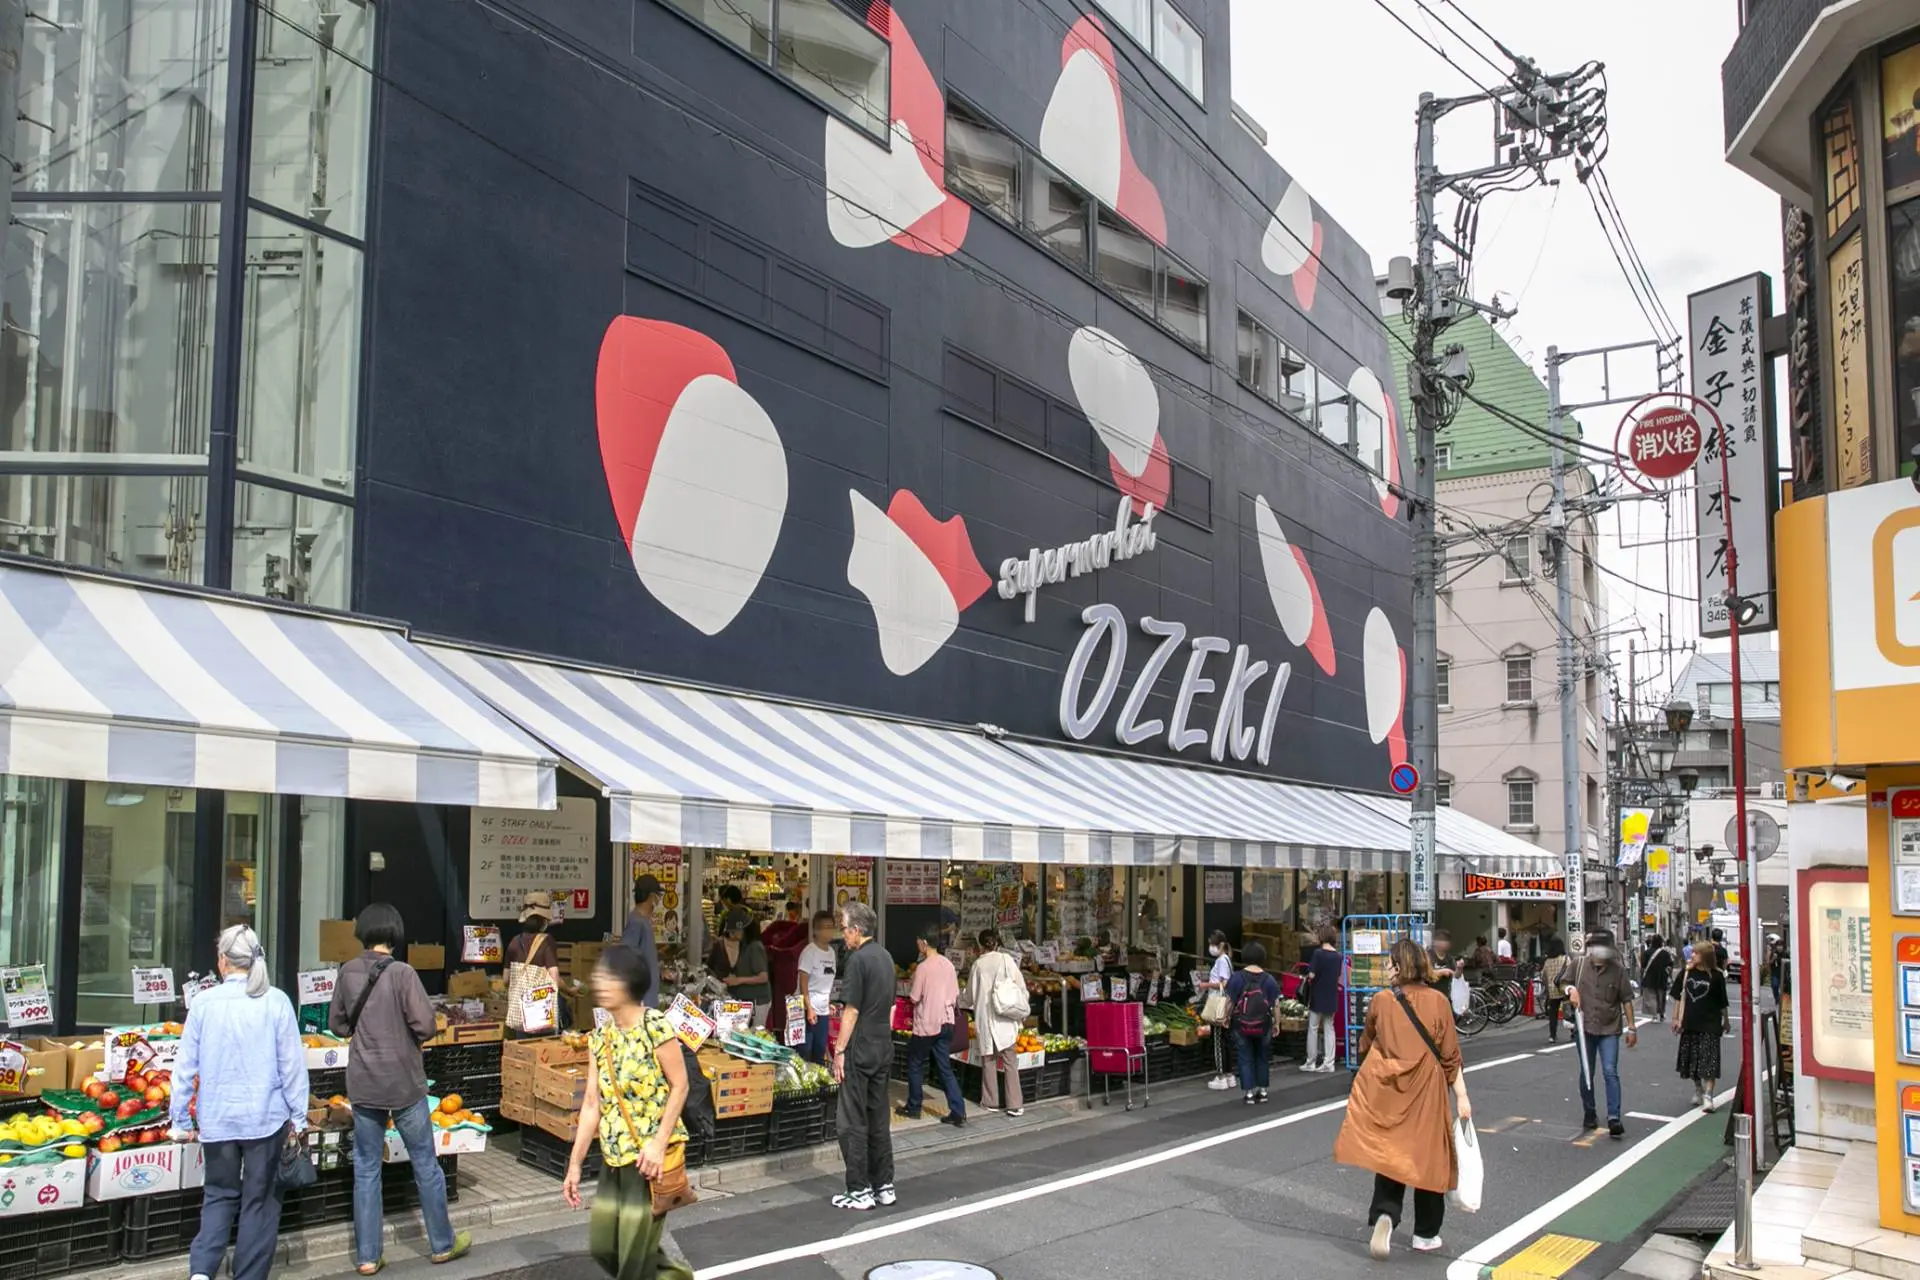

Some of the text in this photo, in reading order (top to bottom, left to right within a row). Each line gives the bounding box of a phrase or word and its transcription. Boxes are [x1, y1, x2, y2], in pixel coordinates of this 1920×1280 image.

[1738, 296, 1757, 443] 葬儀式典一切請負
[1838, 273, 1854, 468] リラクゼーション
[1640, 413, 1687, 429] FIRE HYDRANT
[1635, 424, 1697, 462] 消火栓
[998, 495, 1157, 622] supermarket
[1059, 603, 1291, 766] OZEKI
[481, 818, 494, 826] 4F
[501, 818, 527, 828] STAFF
[529, 820, 553, 830] ONLY
[481, 834, 494, 844] 3F
[501, 835, 529, 845] OZEKI
[480, 861, 494, 870] 2F
[1467, 873, 1564, 893] USED CLOTHI
[478, 946, 498, 957] 599
[145, 980, 168, 992] 299
[313, 980, 334, 992] 299
[678, 1021, 699, 1042] 599
[111, 1150, 173, 1181] AOMORI
